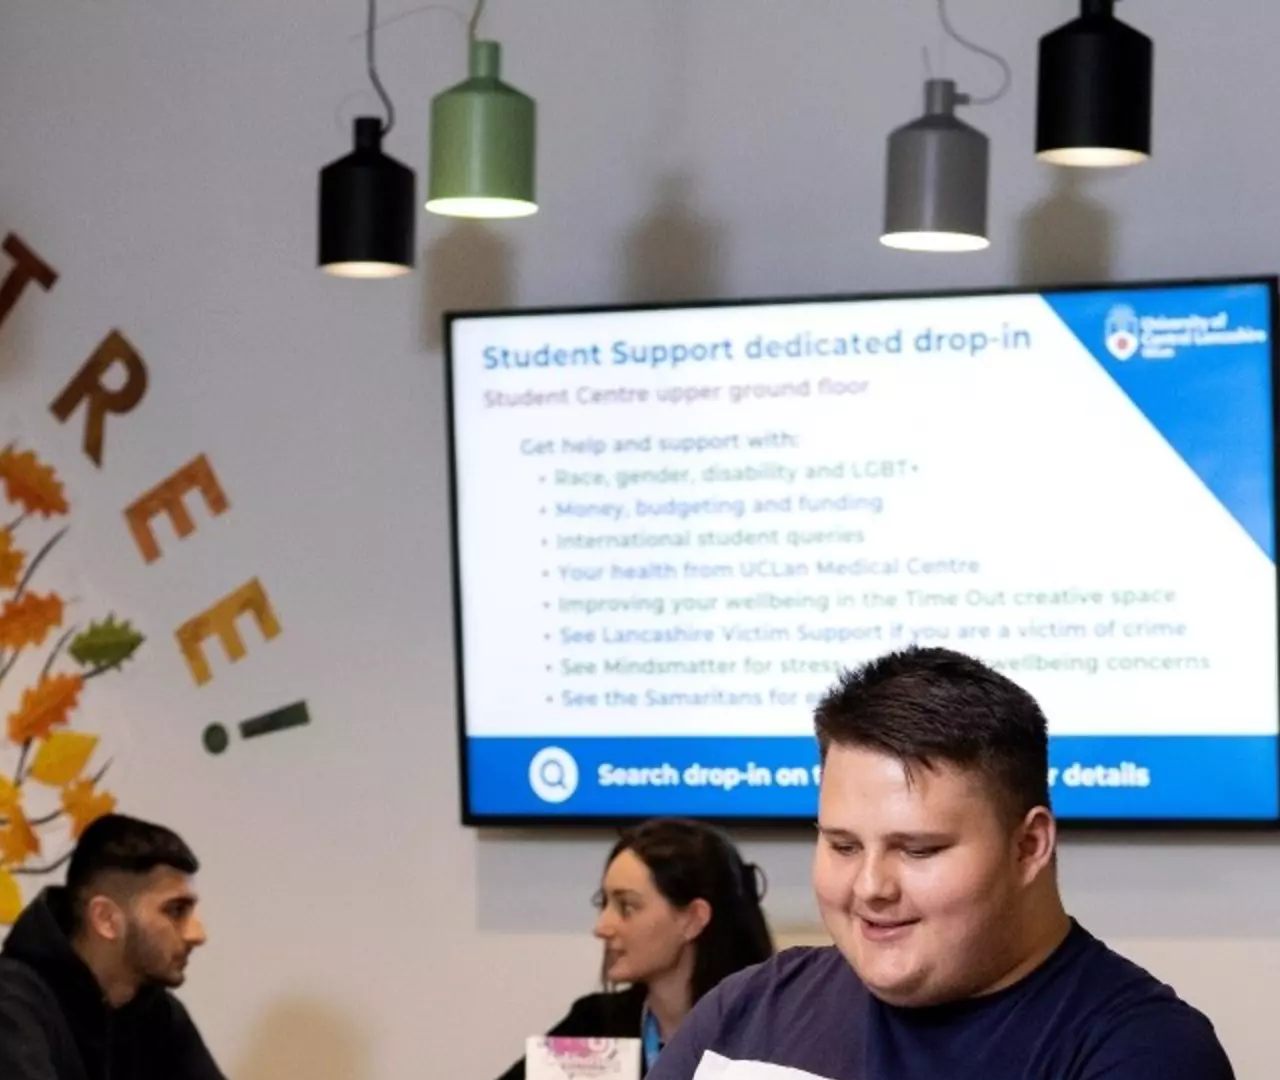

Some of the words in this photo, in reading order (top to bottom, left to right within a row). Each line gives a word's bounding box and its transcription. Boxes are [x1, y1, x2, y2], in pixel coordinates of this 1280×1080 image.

[483, 344, 602, 370] Student
[612, 339, 735, 369] Support
[745, 328, 903, 359] dedicated
[914, 322, 1032, 357] drop-in
[484, 389, 569, 408] Student
[576, 385, 649, 405] Centre
[656, 384, 722, 404] upper
[728, 380, 811, 404] ground
[817, 377, 870, 395] floor
[520, 438, 555, 455] Get
[561, 436, 608, 456] help
[613, 436, 652, 452] and
[659, 433, 740, 453] support
[555, 468, 610, 487] Race,
[616, 466, 696, 489] gender,
[702, 460, 798, 484] disability
[806, 462, 845, 479] and
[555, 502, 630, 521] Money,
[635, 498, 745, 519] budgeting
[753, 497, 792, 514] and
[799, 494, 883, 514] funding
[556, 529, 690, 548] International
[697, 528, 779, 546] student
[786, 526, 865, 547] queries
[558, 564, 604, 581] Your
[610, 562, 677, 579] health
[682, 561, 734, 578] from
[740, 559, 809, 577] UCLan
[816, 558, 899, 575] Medical
[906, 556, 981, 574] Centre
[558, 594, 665, 616] Improving
[670, 597, 718, 616] your
[725, 592, 829, 613] wellbeing
[836, 593, 856, 607] in
[863, 591, 897, 608] the
[906, 590, 958, 607] Time
[965, 588, 1006, 606] Out
[1012, 586, 1104, 606] creative
[1111, 589, 1177, 607] space
[559, 627, 596, 644] See
[601, 625, 715, 643] Lancashire
[721, 623, 790, 641] Victim
[797, 624, 883, 643] Support
[890, 622, 904, 640] if
[910, 625, 950, 642] you
[957, 625, 990, 639] are
[998, 625, 1010, 638] a
[1017, 620, 1087, 638] victim
[1093, 619, 1116, 637] of
[1122, 620, 1187, 638] crime
[560, 658, 597, 675] See
[603, 657, 737, 675] Mindsmatter
[743, 656, 771, 674] for
[1106, 655, 1211, 671] concerns
[561, 689, 598, 707] See
[604, 687, 638, 706] the
[644, 687, 762, 706] Samaritans
[769, 687, 798, 705] for
[597, 762, 680, 787] Search
[682, 762, 771, 791] drop-in
[775, 767, 809, 787] on
[1062, 760, 1151, 788] details
